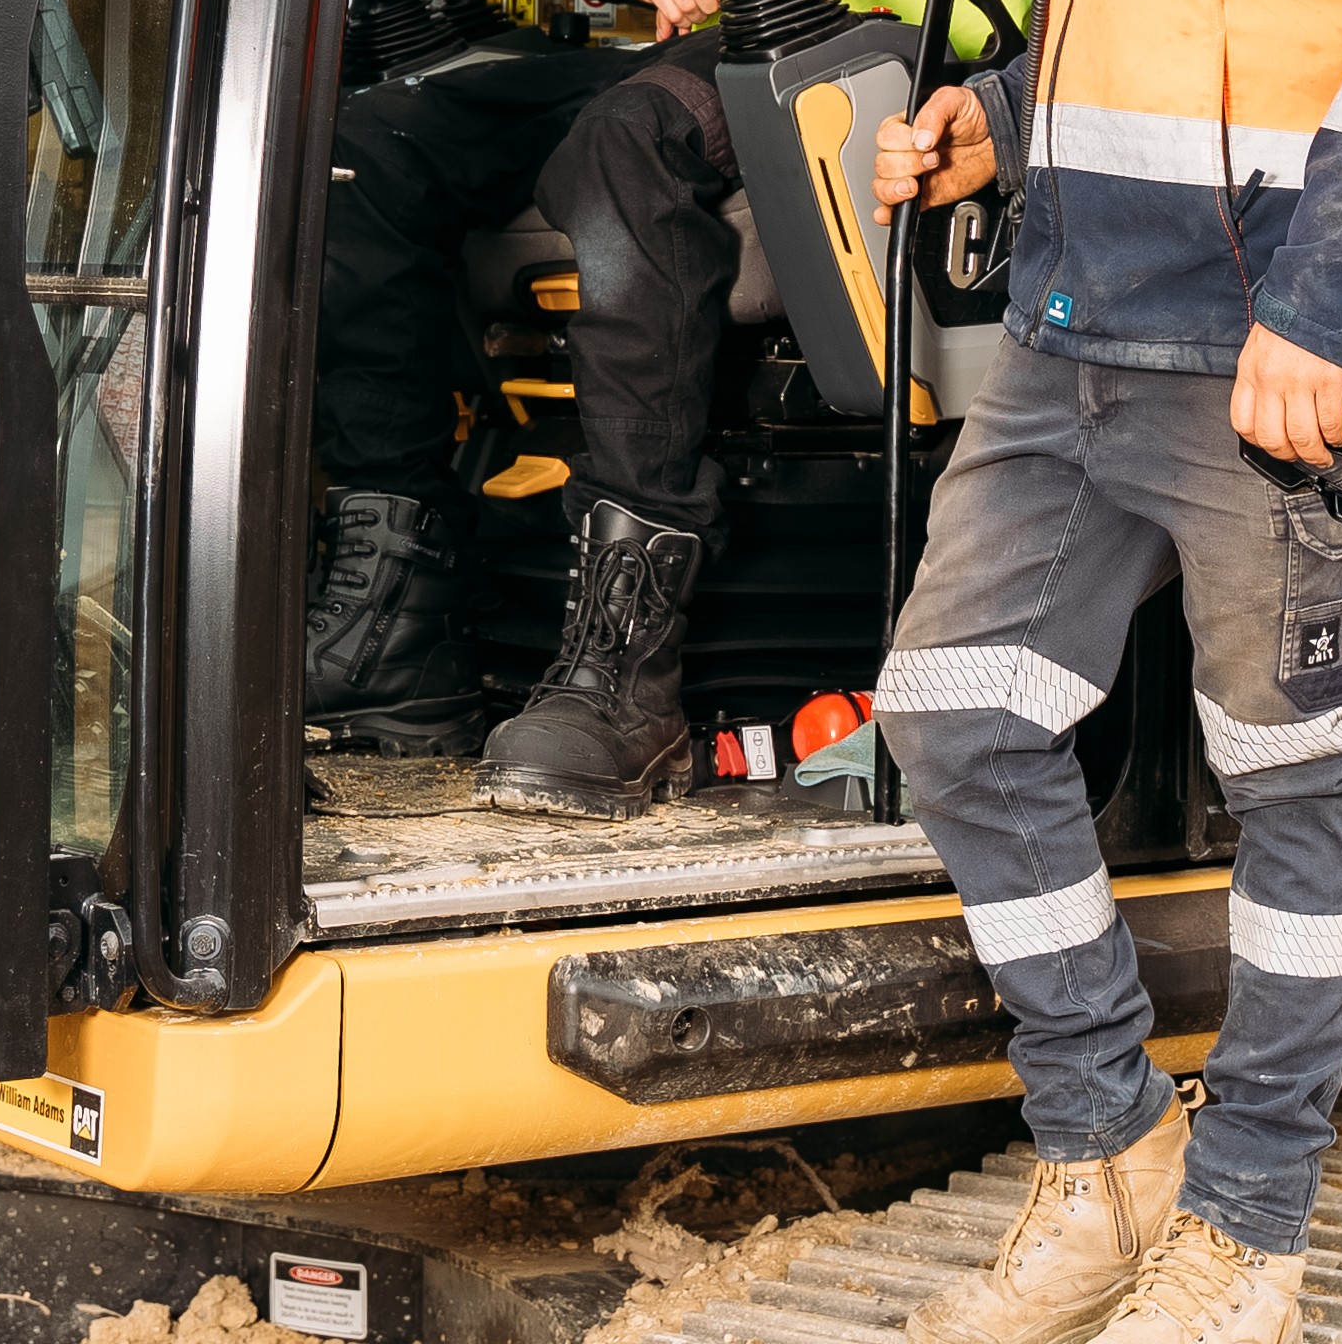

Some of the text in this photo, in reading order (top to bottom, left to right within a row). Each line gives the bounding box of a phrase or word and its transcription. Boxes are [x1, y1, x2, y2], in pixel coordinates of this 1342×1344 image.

[1308, 647, 1334, 665] UNIT
[32, 1094, 65, 1124] Adams
[72, 1104, 99, 1142] CAT
[296, 1267, 337, 1283] DANGER
